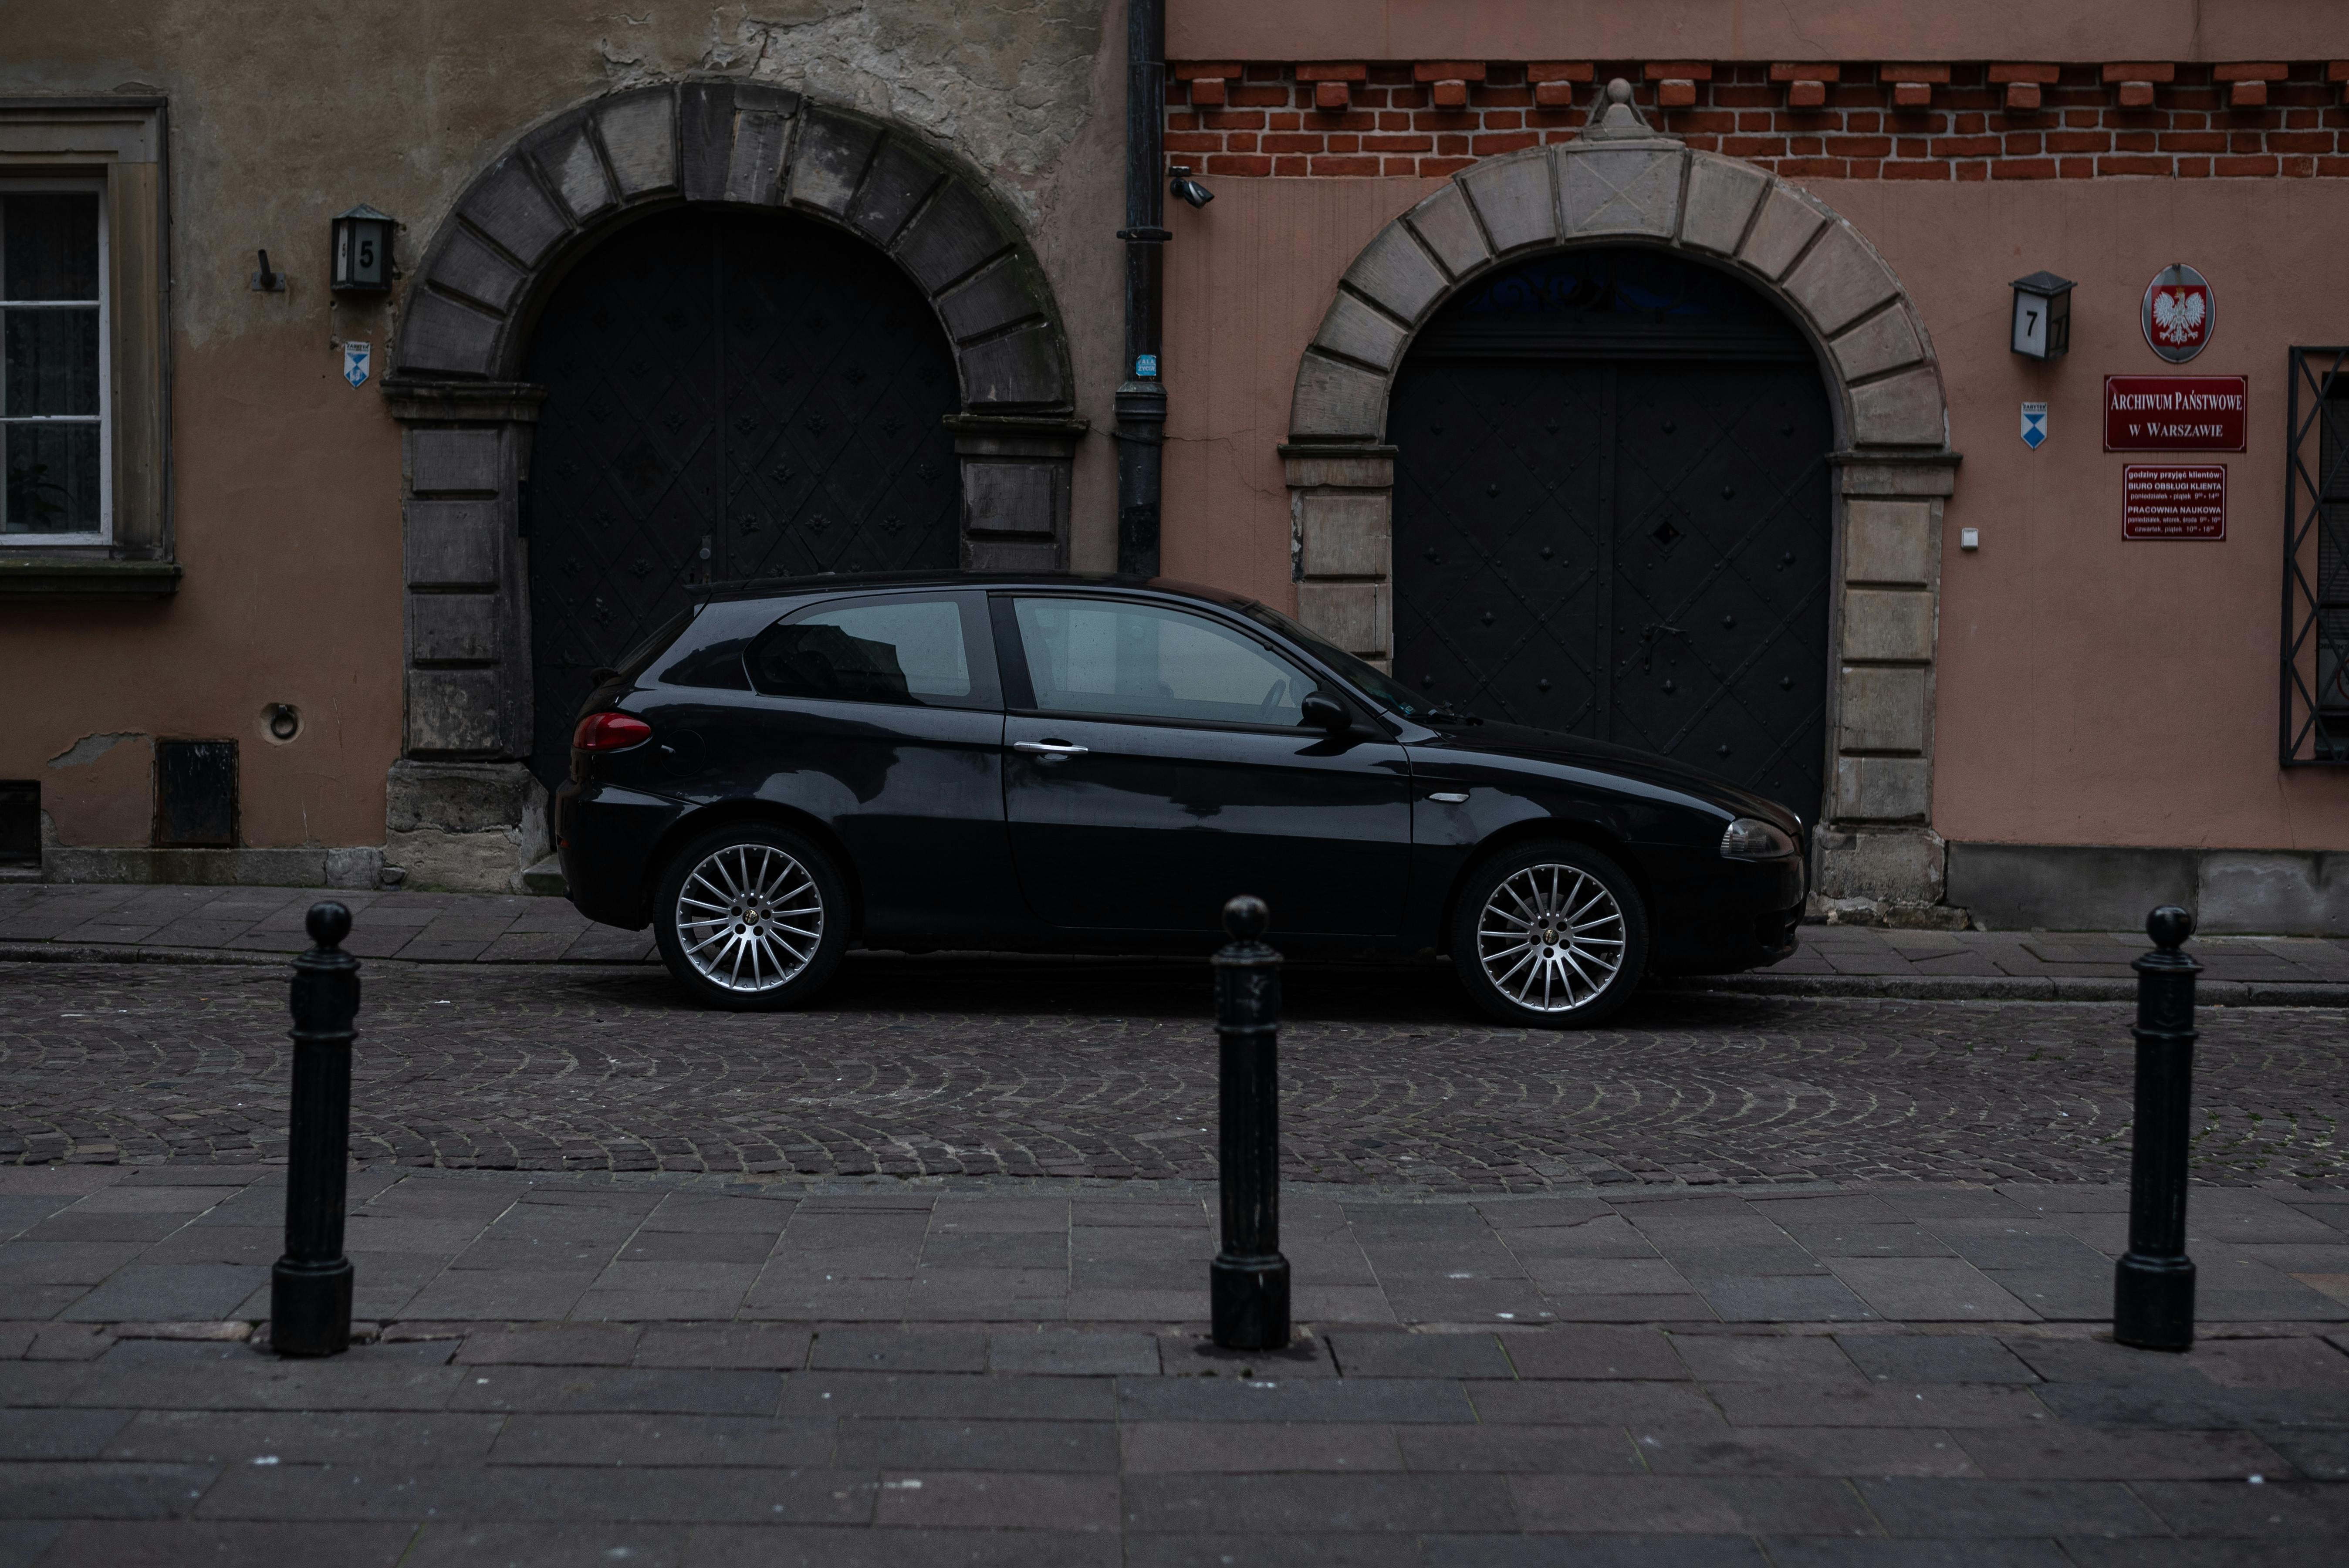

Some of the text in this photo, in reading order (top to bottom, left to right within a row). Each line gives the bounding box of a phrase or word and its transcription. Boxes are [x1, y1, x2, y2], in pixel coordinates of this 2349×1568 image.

[359, 240, 374, 269] 5
[2026, 311, 2038, 337] 7
[2111, 390, 2242, 411] ARCHIWUM PAŃSTWOWE
[2146, 422, 2223, 438] WARSZAWIE
[2129, 471, 2158, 480] godziny
[2160, 471, 2187, 480] przyjęć
